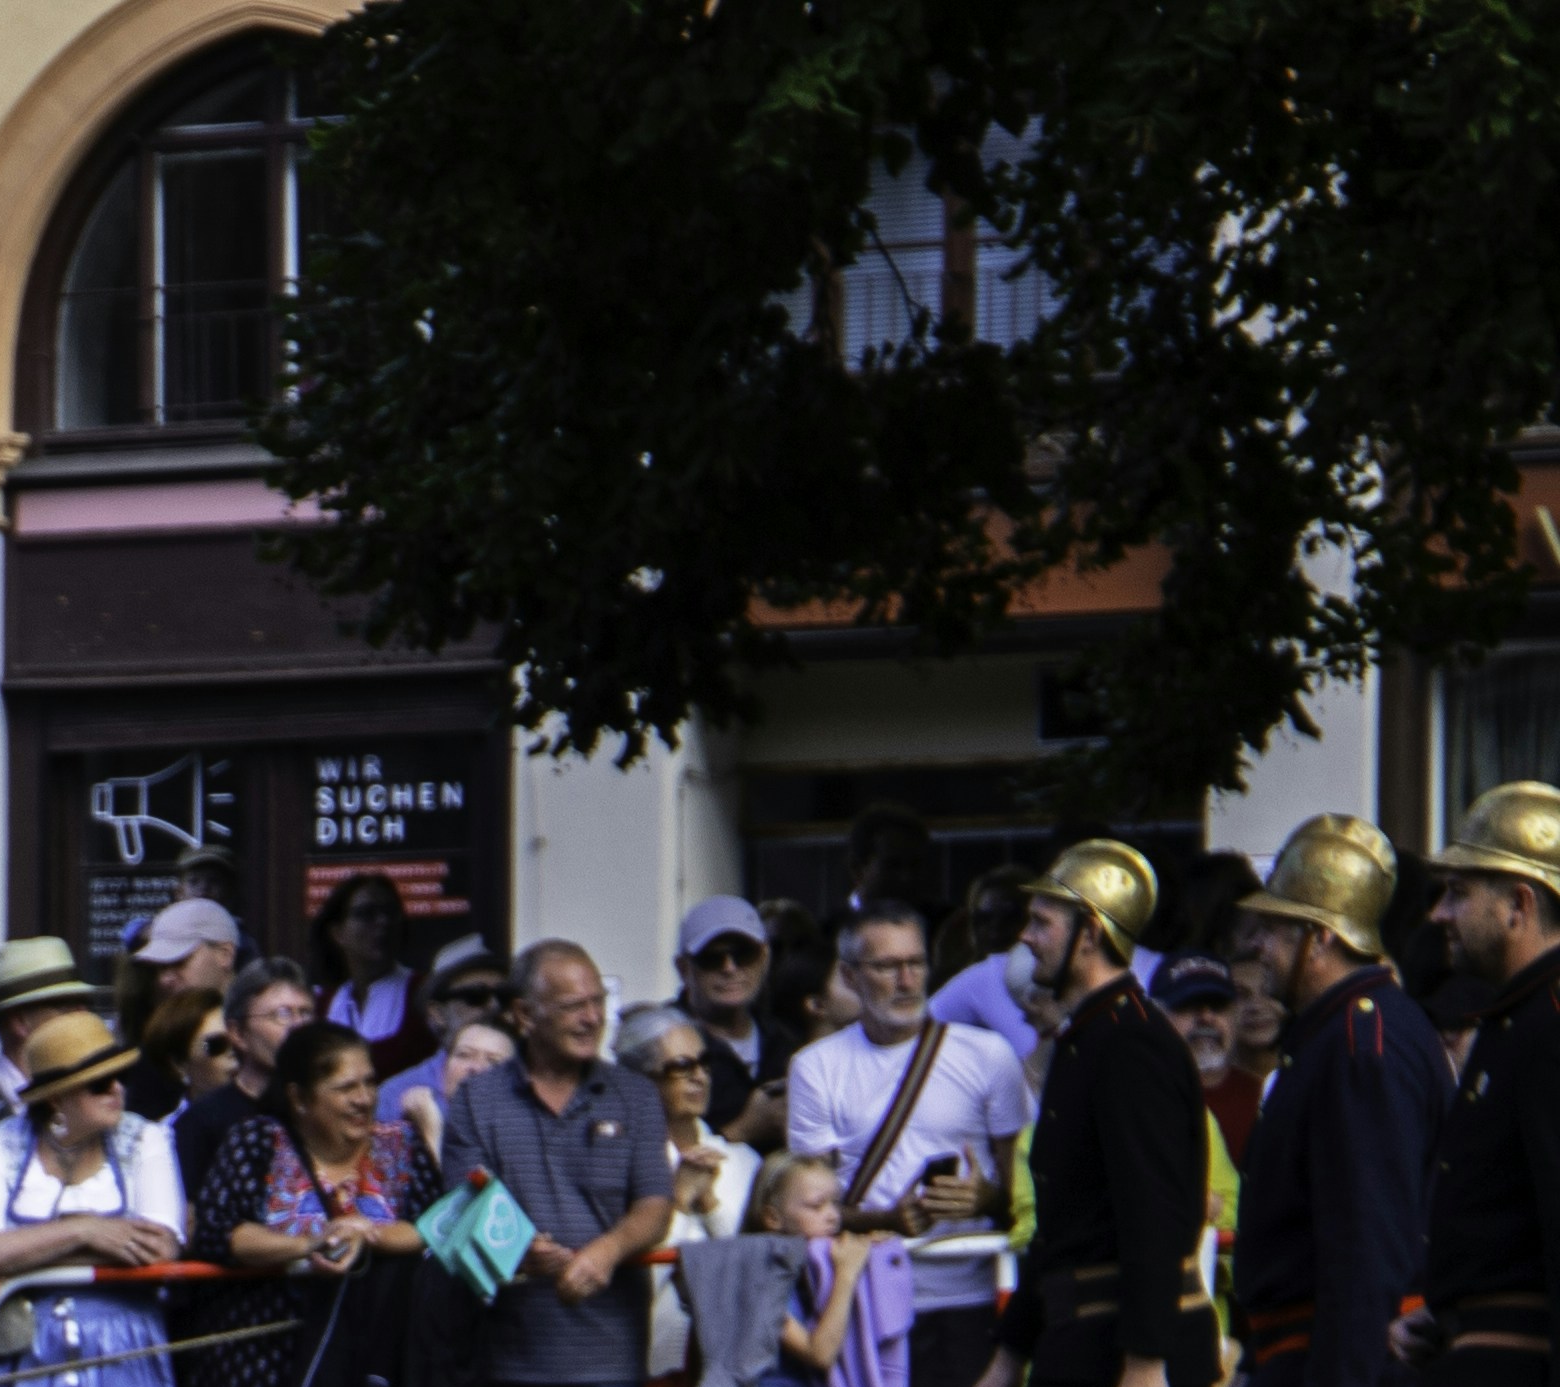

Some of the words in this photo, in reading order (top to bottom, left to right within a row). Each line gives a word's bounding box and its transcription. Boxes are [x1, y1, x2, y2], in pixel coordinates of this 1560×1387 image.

[317, 755, 382, 782] WIR
[316, 782, 464, 815] SUCHEN
[316, 815, 406, 846] DICH
